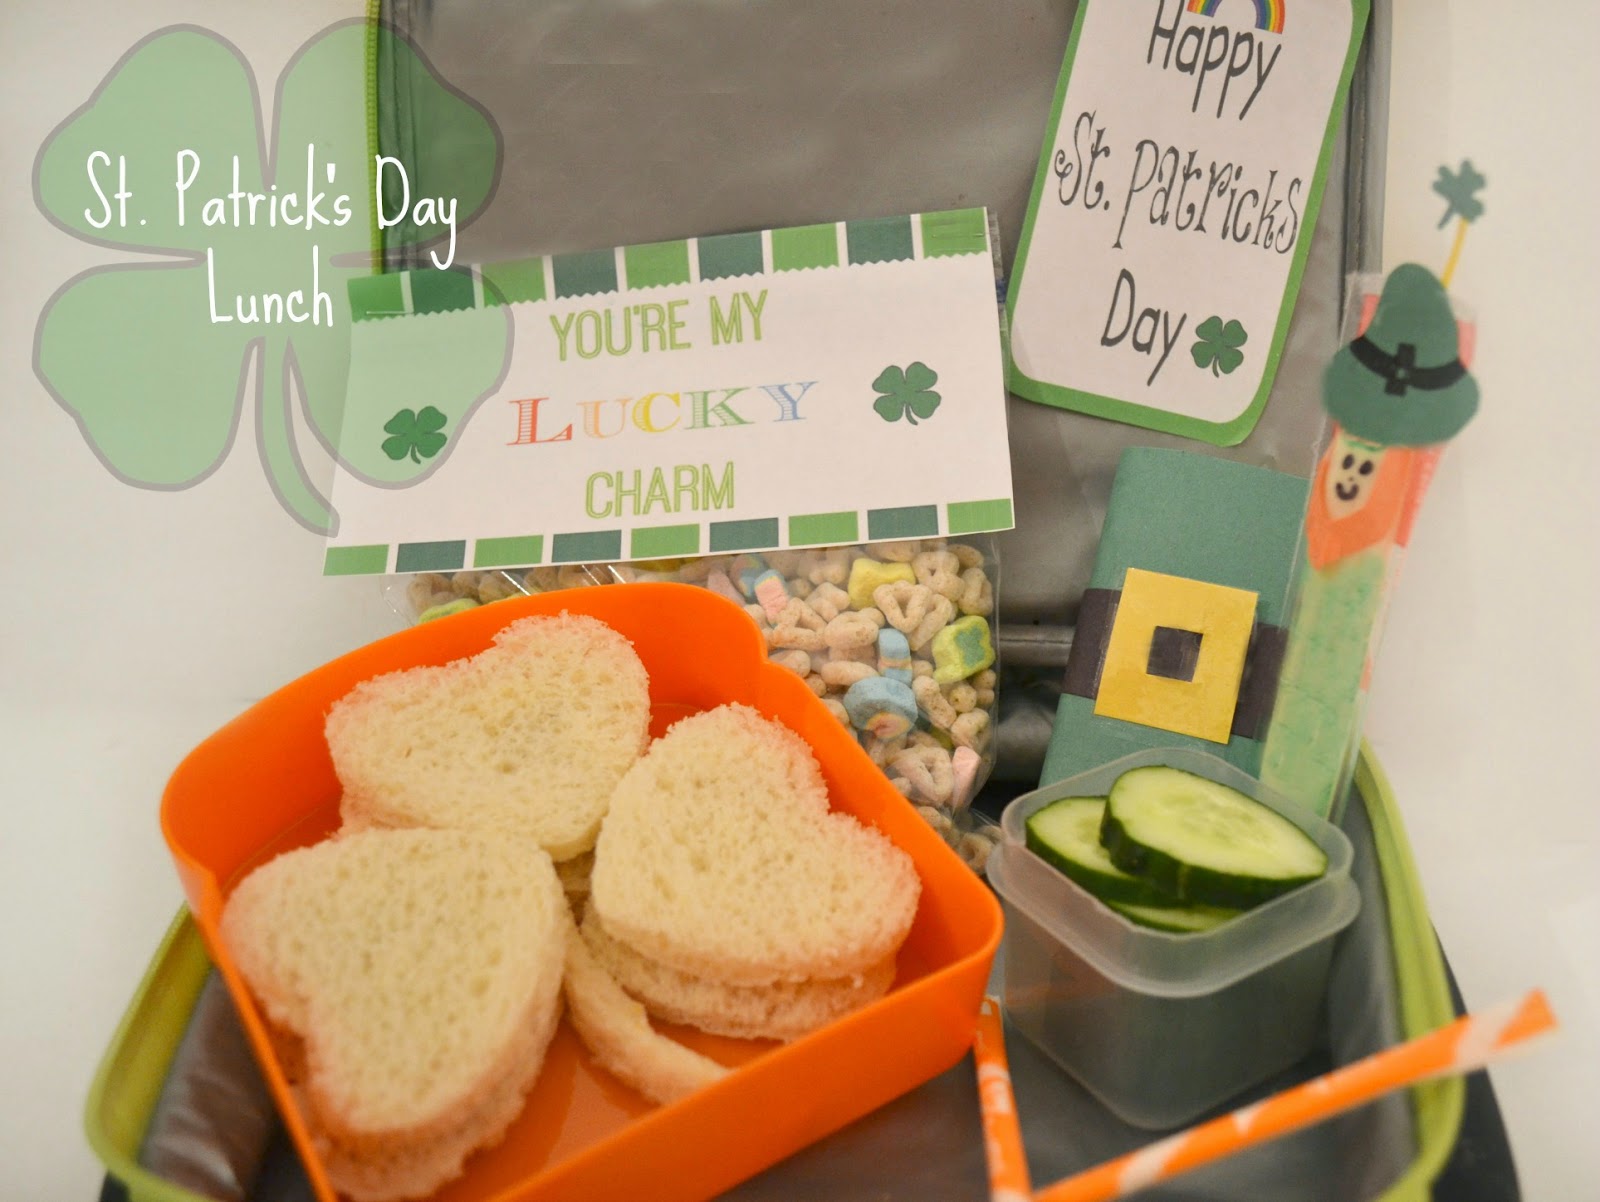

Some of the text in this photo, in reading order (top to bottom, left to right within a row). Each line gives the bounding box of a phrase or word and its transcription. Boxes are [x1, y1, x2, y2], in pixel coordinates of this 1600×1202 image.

[1147, 0, 1281, 120] Happy
[1054, 110, 1302, 254] St. Patricks
[549, 290, 768, 361] YOU'RE MY
[1101, 268, 1187, 386] Day
[506, 381, 819, 445] LUCKY
[585, 462, 735, 519] CHARM
